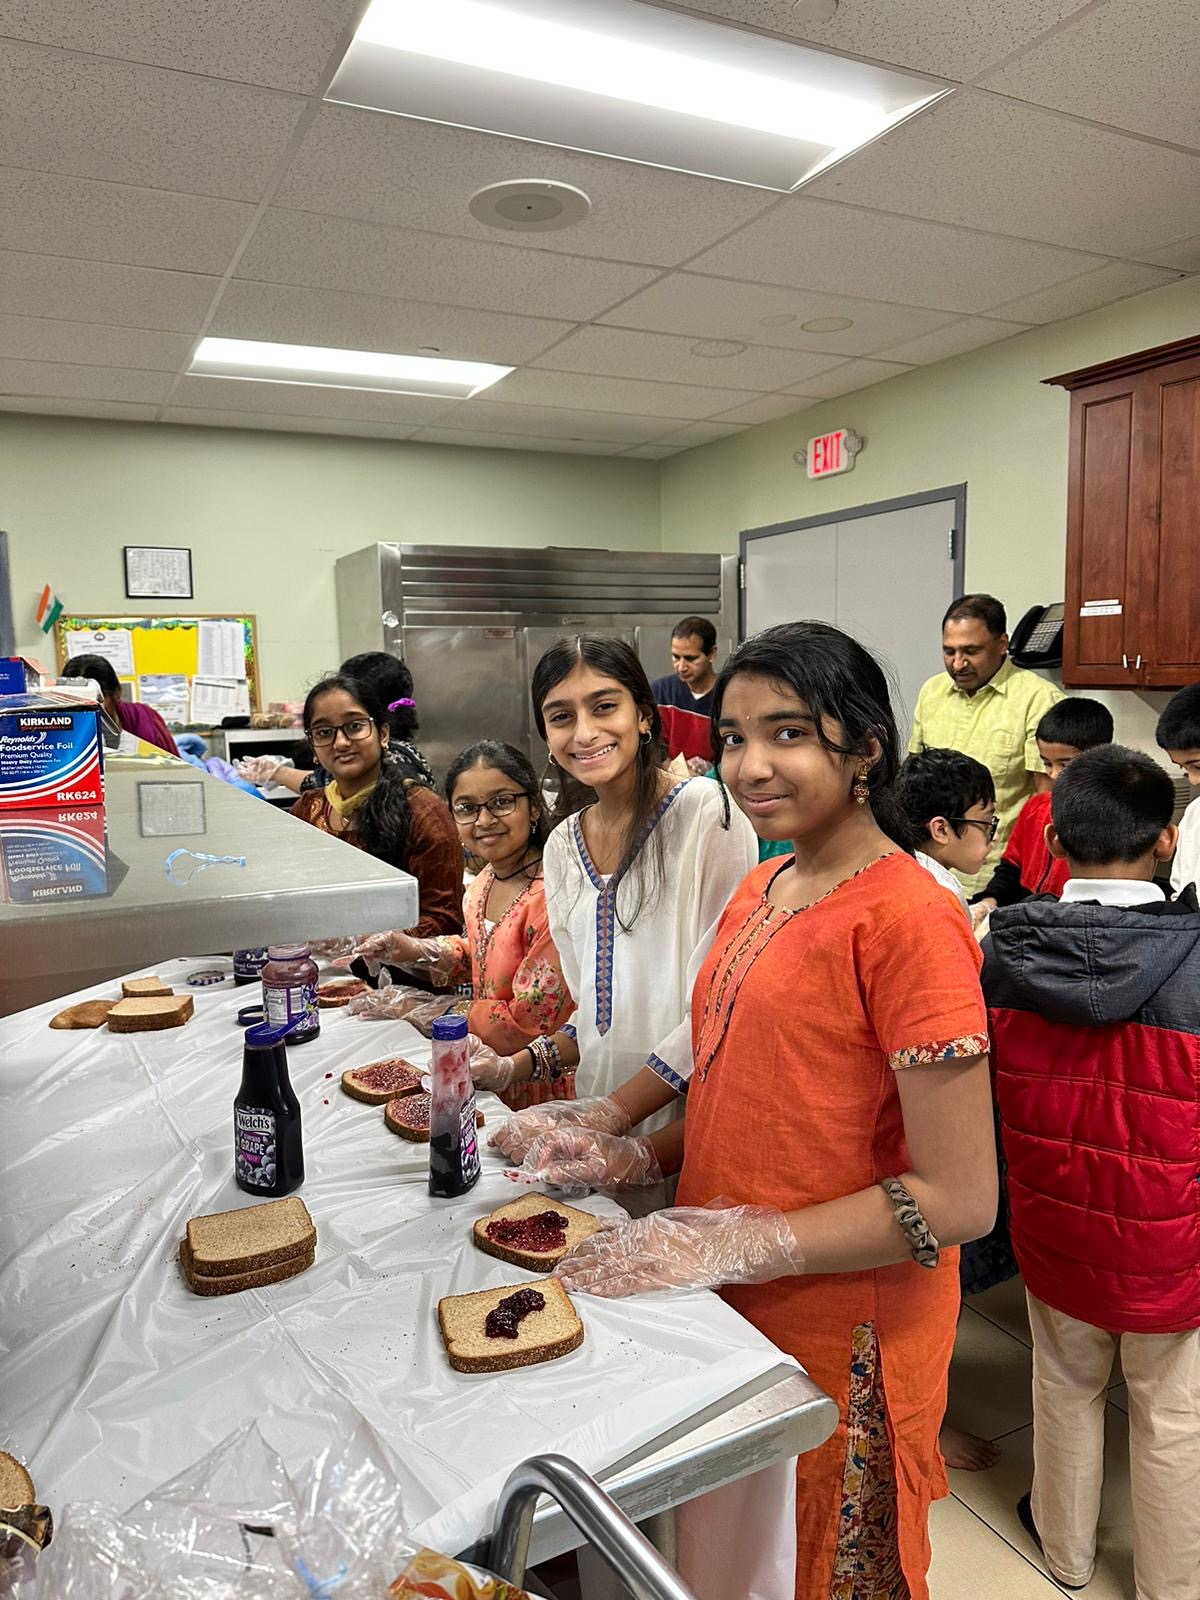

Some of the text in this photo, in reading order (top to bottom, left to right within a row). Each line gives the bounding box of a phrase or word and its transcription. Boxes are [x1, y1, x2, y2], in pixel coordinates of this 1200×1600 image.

[814, 431, 842, 475] EXIT
[20, 717, 72, 726] KIRKLAND
[0, 735, 38, 744] Reynolds
[0, 742, 73, 751] Foodservice Foil
[56, 791, 96, 801] RK624
[239, 1114, 270, 1129] Welch's
[240, 1138, 265, 1155] GRAPE
